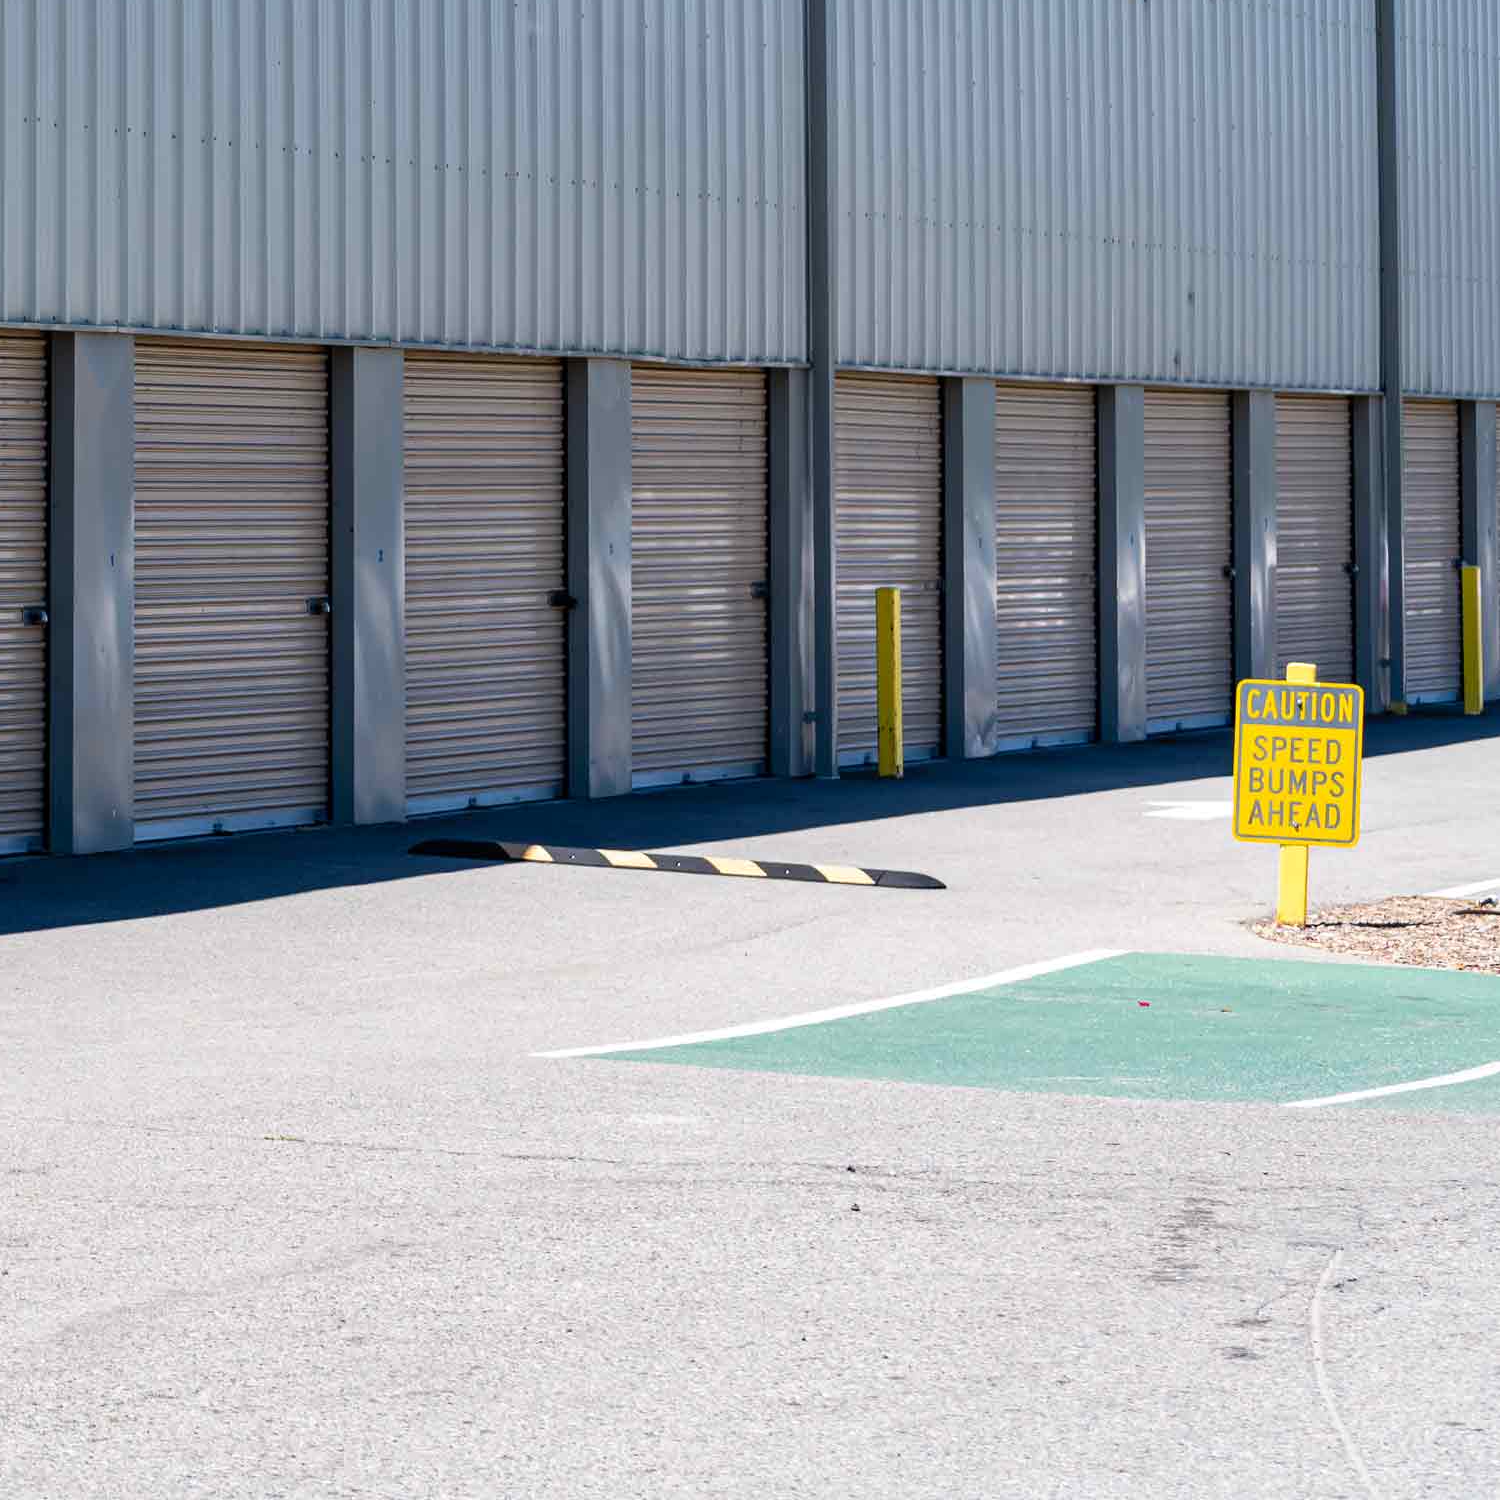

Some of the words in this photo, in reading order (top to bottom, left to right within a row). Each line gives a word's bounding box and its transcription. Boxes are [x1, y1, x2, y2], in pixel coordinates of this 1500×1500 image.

[1247, 687, 1353, 723] CAUTION
[1253, 735, 1342, 765] SPEED
[1249, 767, 1345, 797] BUMPS
[1247, 800, 1342, 829] AHEAD
